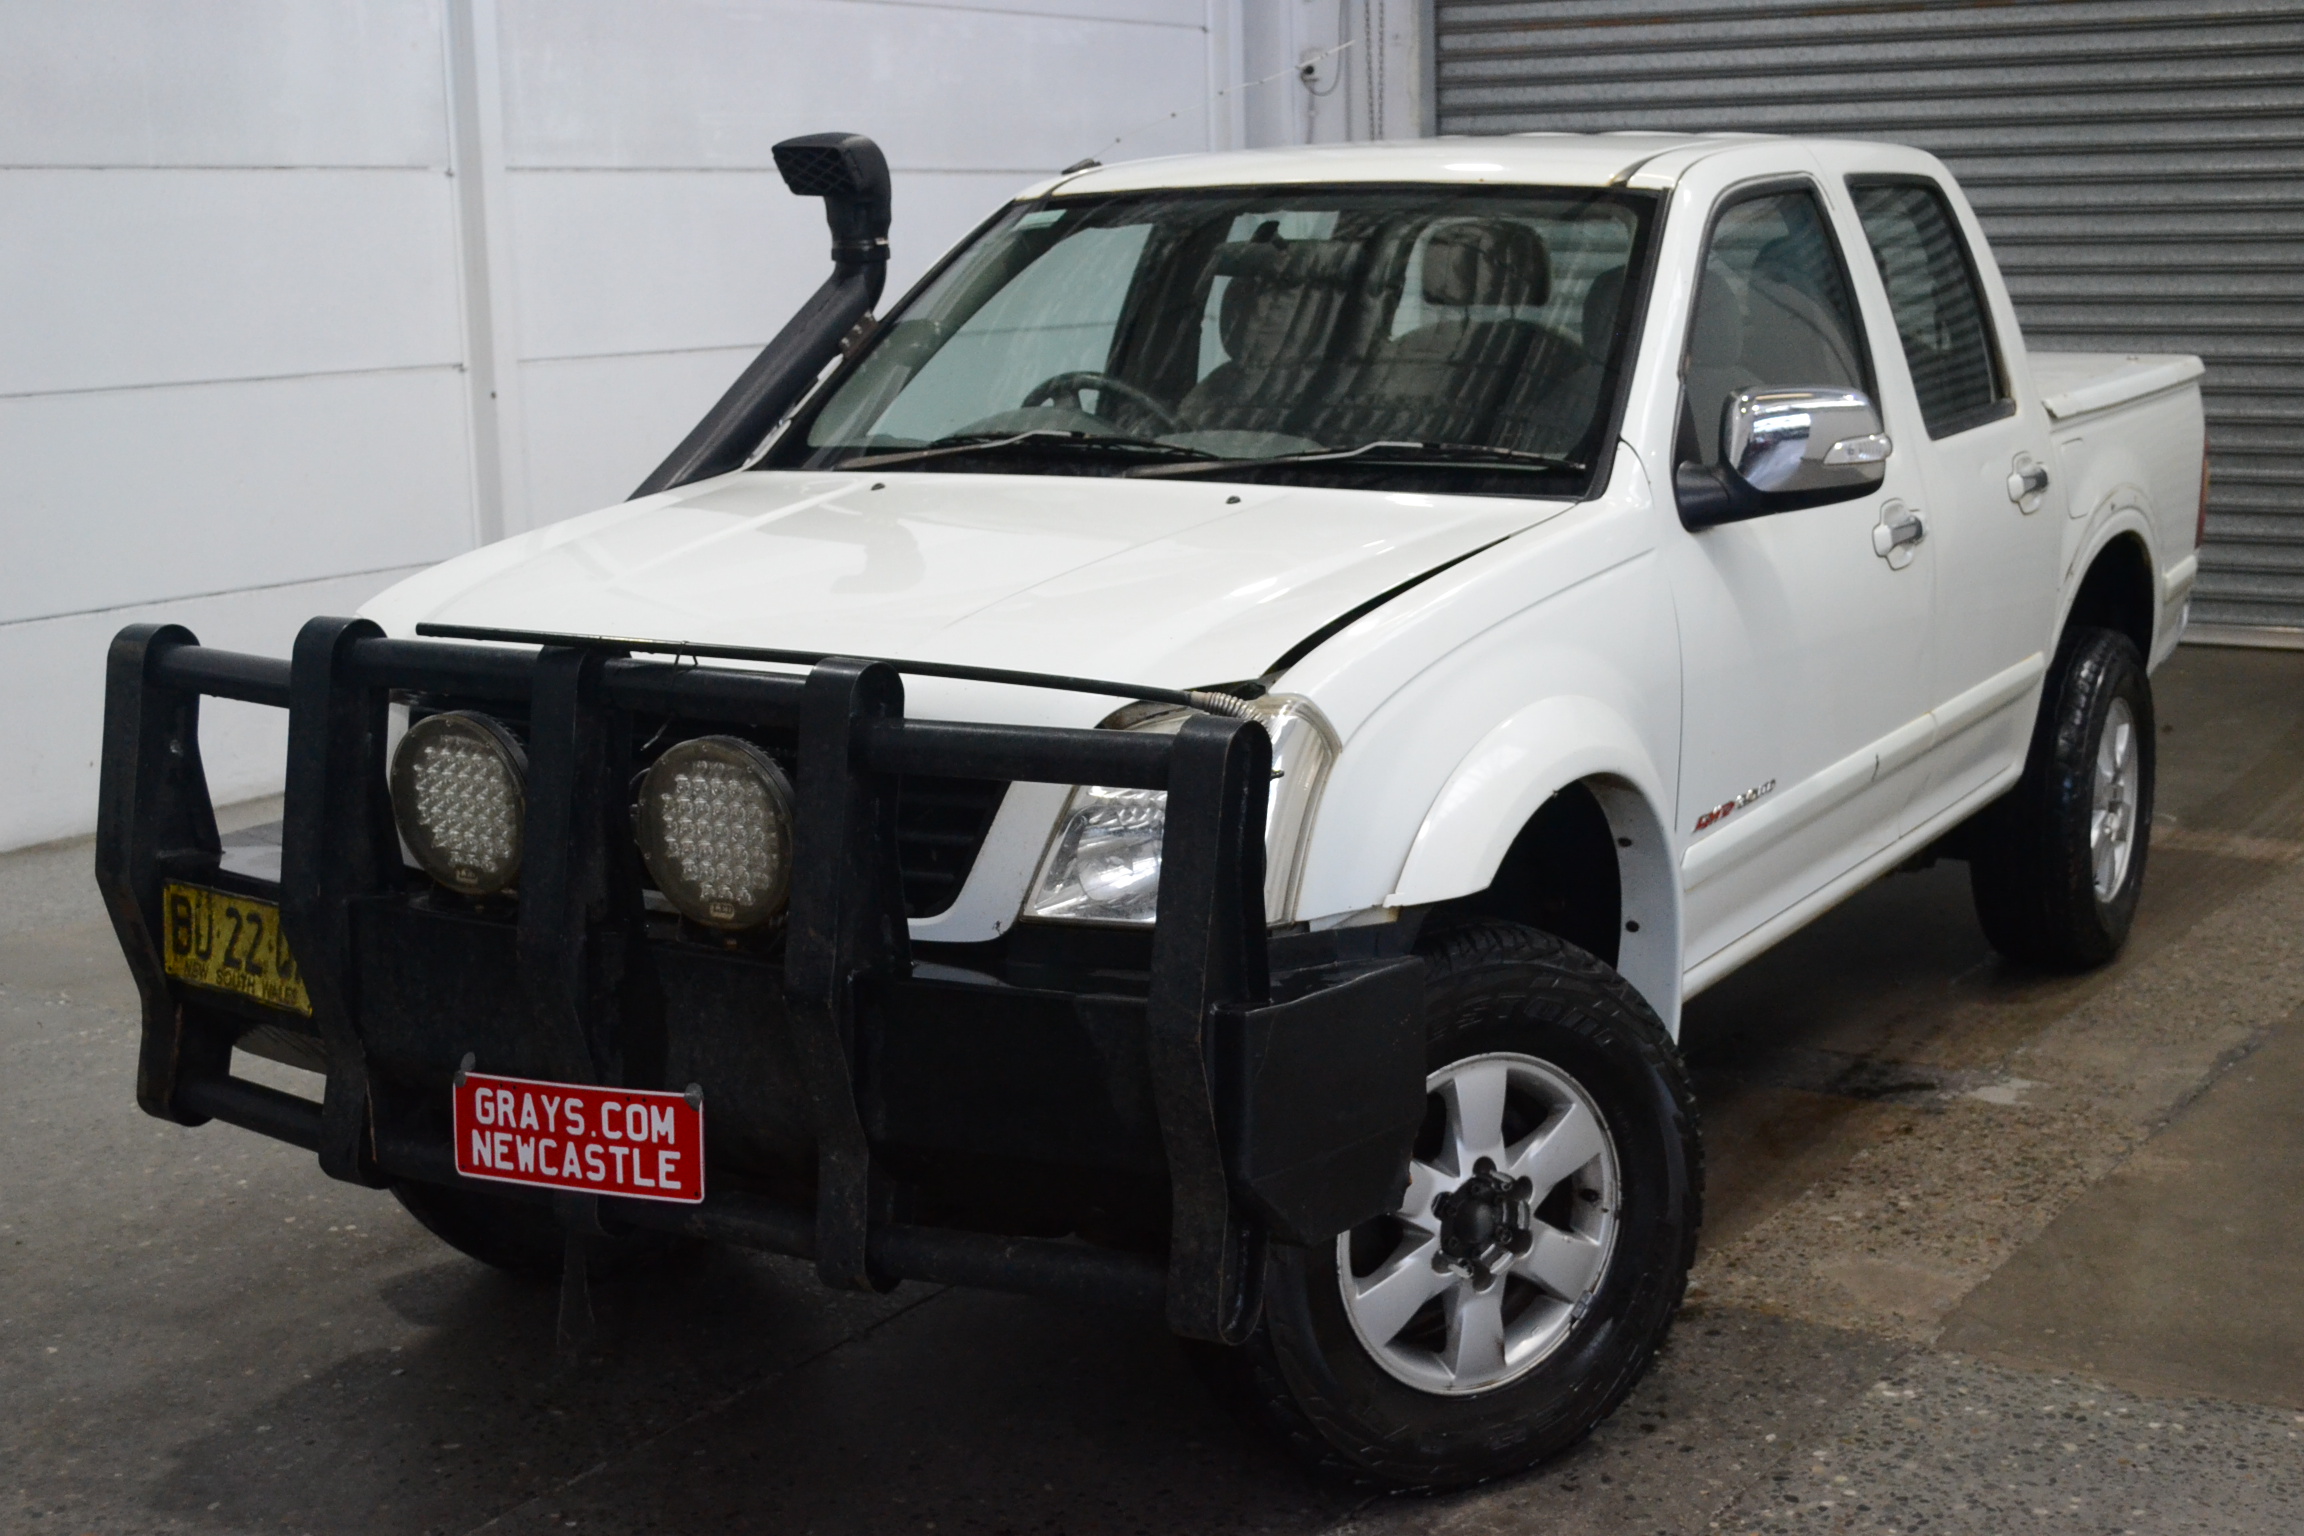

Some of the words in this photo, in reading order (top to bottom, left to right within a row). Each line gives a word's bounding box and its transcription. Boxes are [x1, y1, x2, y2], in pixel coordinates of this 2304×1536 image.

[183, 960, 208, 979] NEW
[215, 967, 256, 994] SOUTH
[474, 1086, 675, 1145] GRAYS.COM
[471, 1128, 682, 1190] NEWCASTLE
